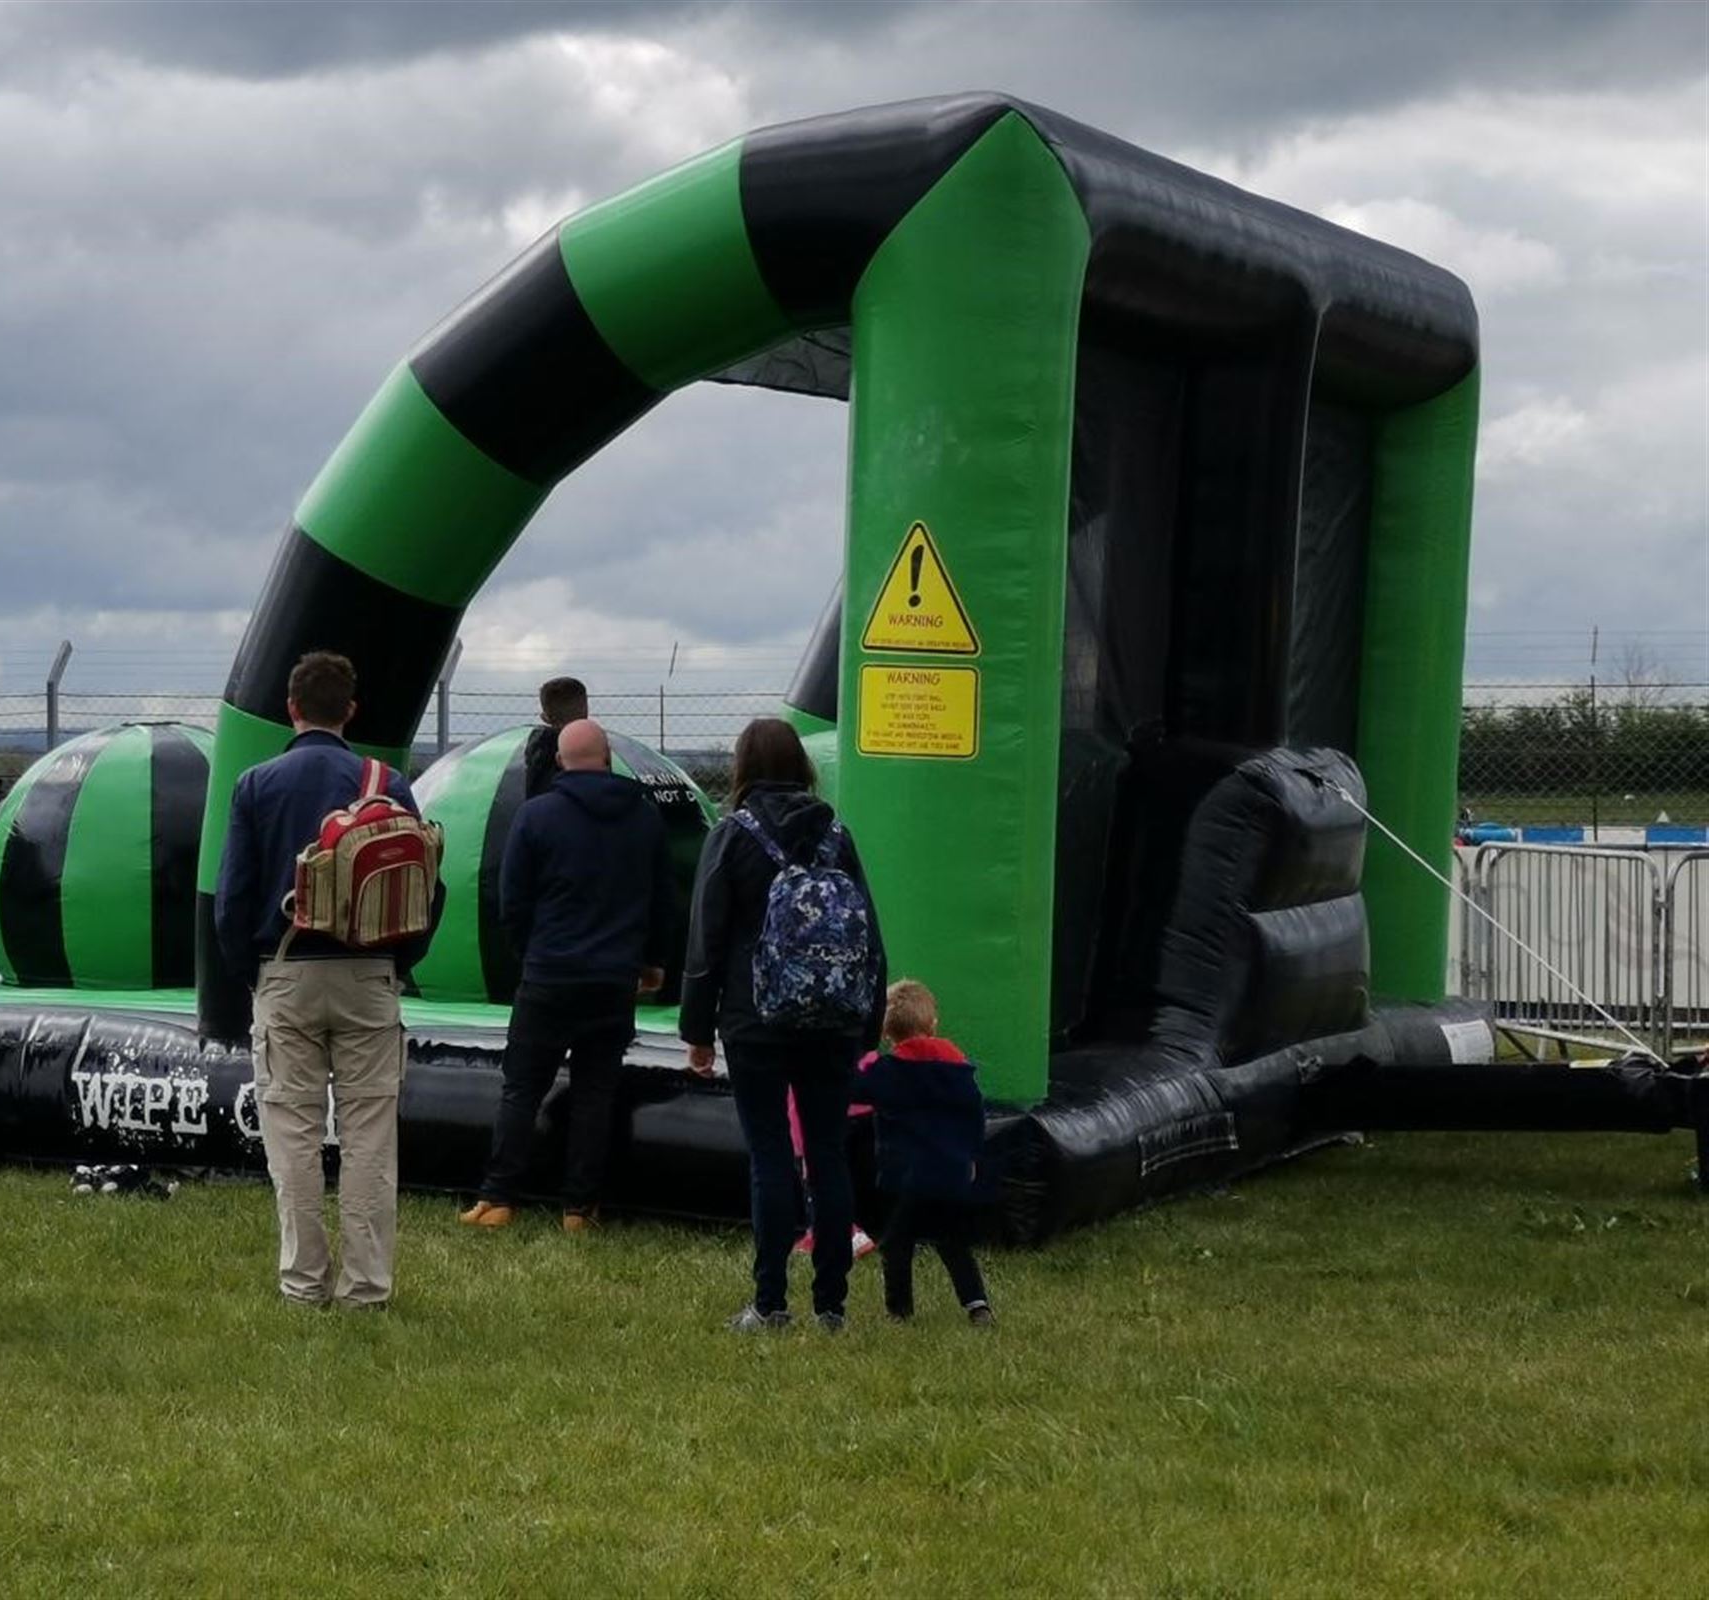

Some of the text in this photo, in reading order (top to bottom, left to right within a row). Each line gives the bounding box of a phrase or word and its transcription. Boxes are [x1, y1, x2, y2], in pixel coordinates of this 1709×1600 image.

[889, 614, 943, 628] WARNING
[887, 672, 941, 685] WARNING
[654, 790, 679, 803] NOT
[71, 1071, 209, 1135] WIPE
